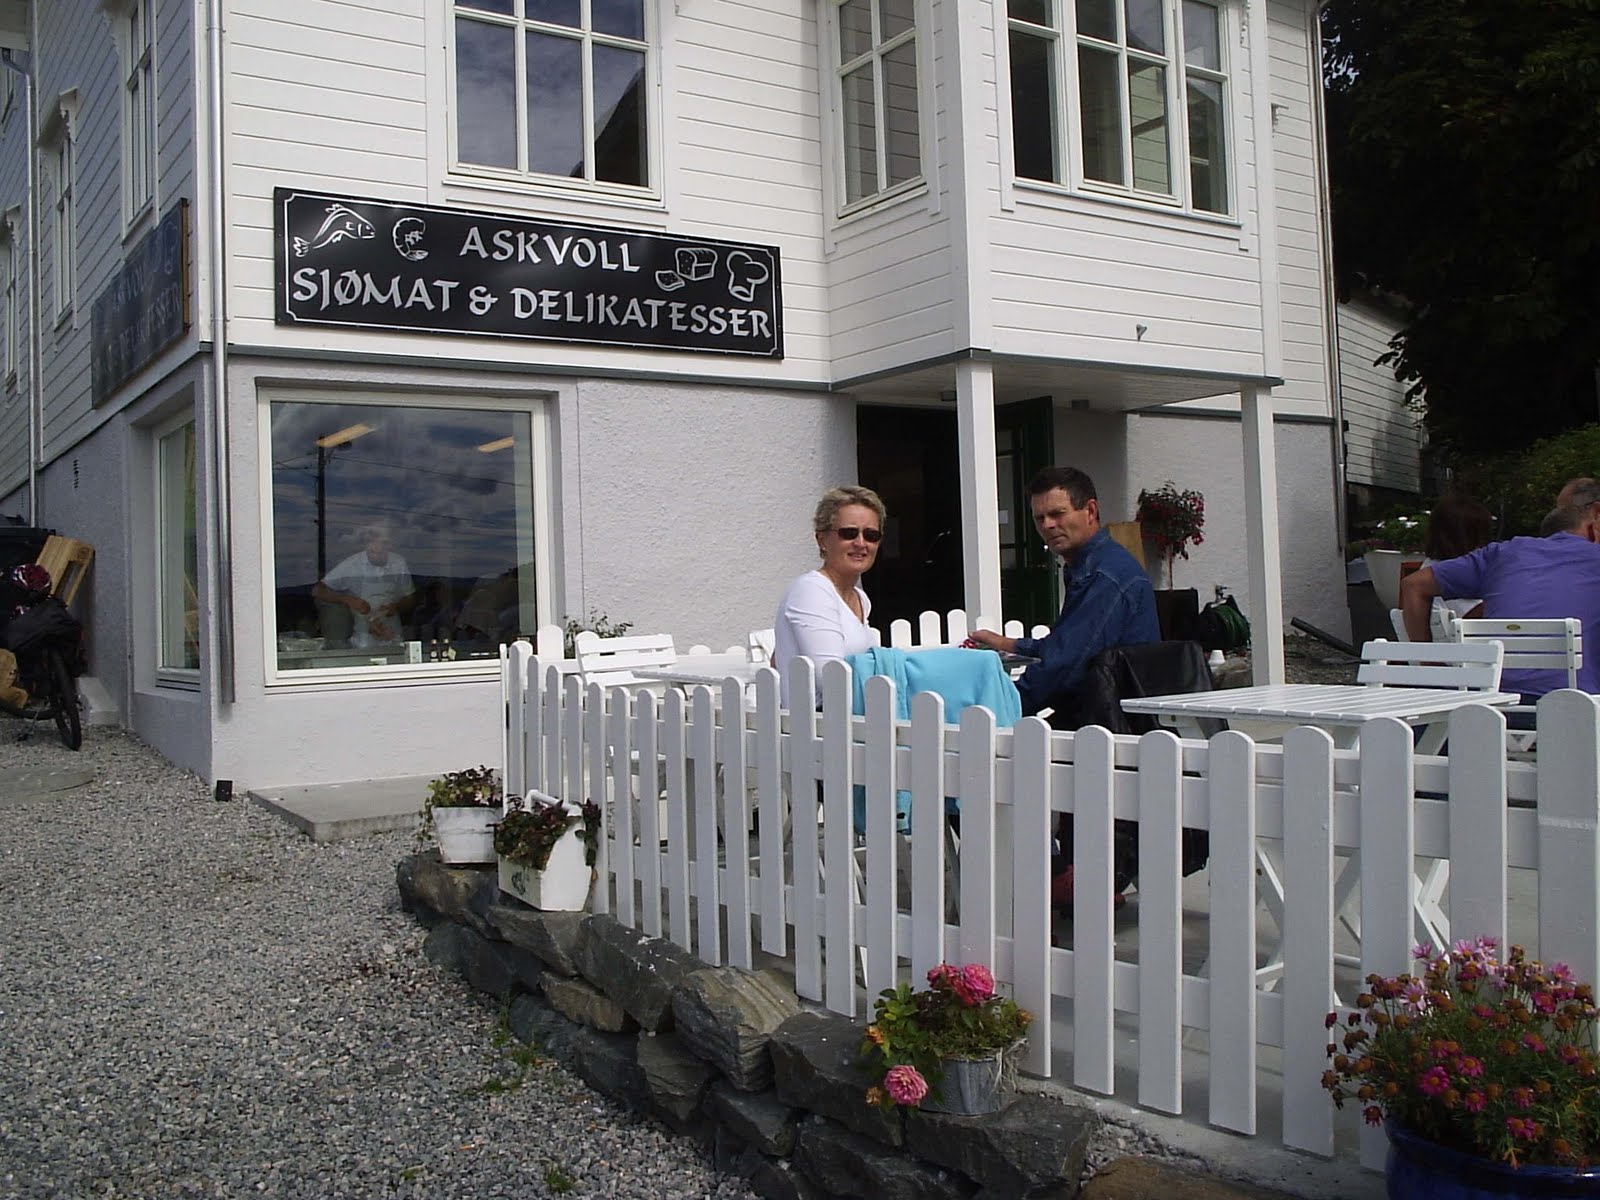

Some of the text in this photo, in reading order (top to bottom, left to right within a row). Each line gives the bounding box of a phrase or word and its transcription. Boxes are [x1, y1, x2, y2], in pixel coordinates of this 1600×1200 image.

[459, 226, 641, 273] ASKVOLL
[292, 267, 772, 340] SJØMAT & DELIKATESSER
